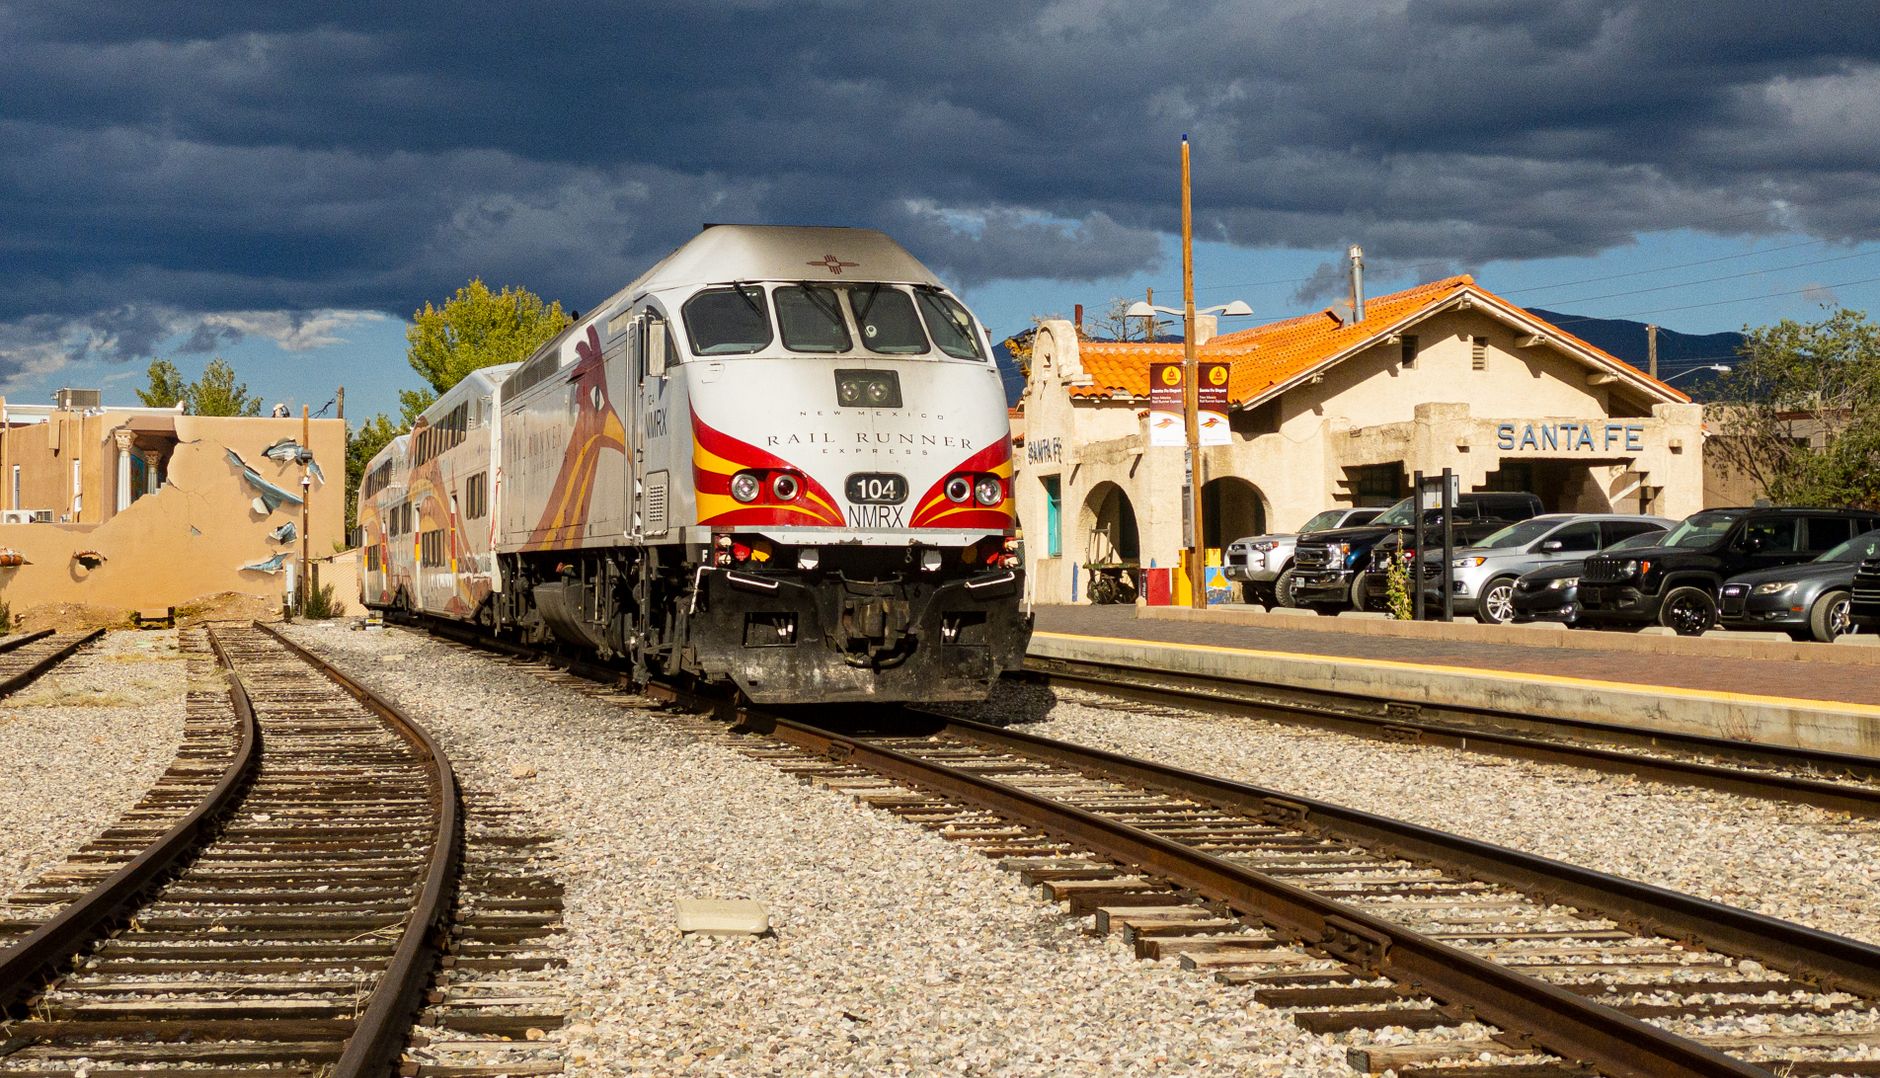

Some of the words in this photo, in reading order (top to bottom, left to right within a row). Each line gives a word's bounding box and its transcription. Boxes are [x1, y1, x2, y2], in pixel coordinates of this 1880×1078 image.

[858, 411, 944, 420] MEXICO
[767, 432, 835, 446] RAIL
[857, 432, 973, 449] RUNNER
[1497, 423, 1595, 451] SANTA
[1604, 424, 1644, 451] FE
[822, 448, 928, 456] EXPRESS
[1027, 438, 1053, 465] SANTA
[857, 479, 896, 499] 104
[849, 505, 904, 528] NMRX
[702, 549, 708, 562] F
